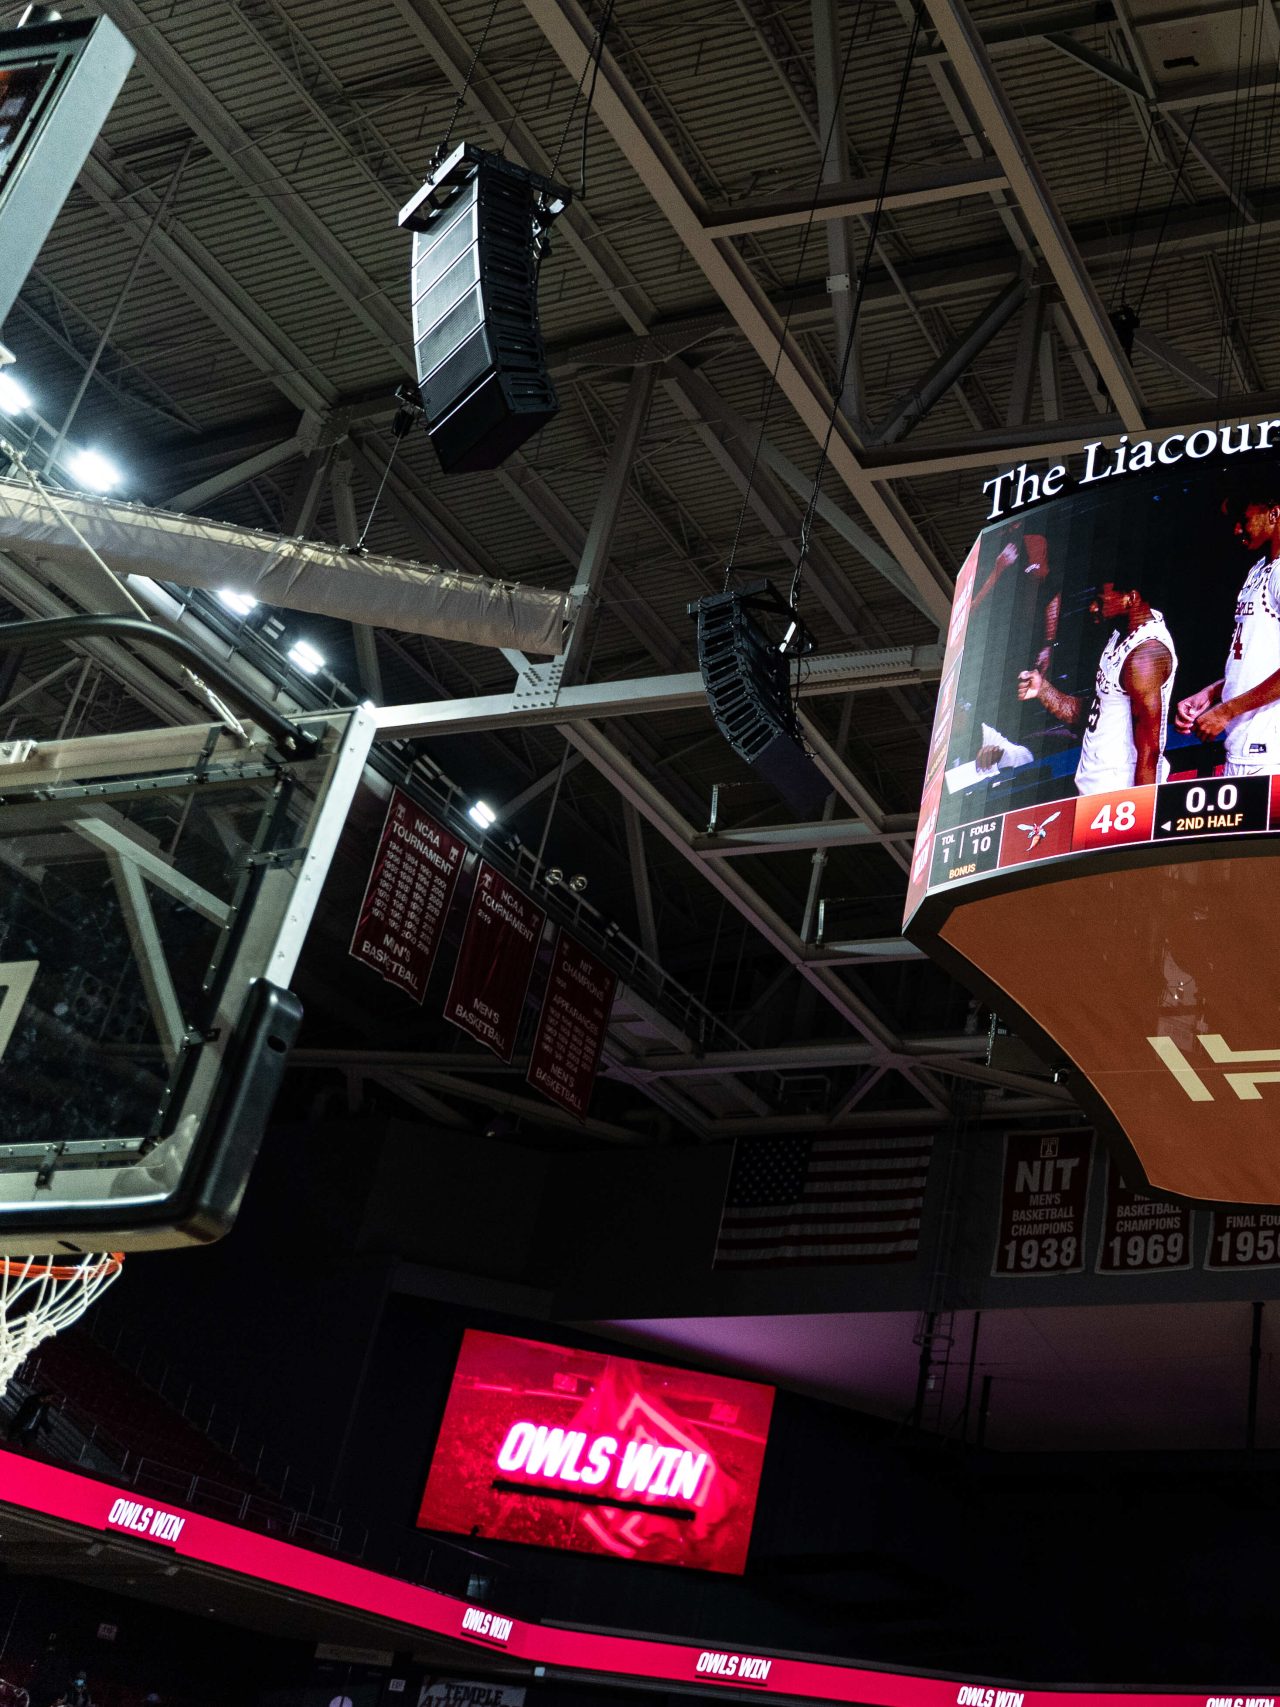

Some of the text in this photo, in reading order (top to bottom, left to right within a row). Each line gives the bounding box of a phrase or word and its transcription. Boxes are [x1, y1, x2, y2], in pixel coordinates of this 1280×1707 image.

[982, 464, 1066, 521] The
[1186, 784, 1238, 813] 0.0
[970, 822, 996, 837] FOULS
[1090, 801, 1136, 833] 48
[1176, 814, 1243, 831] 2ND HALF
[414, 819, 440, 848] NCAA
[941, 834, 955, 847] TOL
[971, 837, 991, 855] 10
[393, 820, 454, 876] TOURNAMENT
[942, 848, 950, 864] 1
[949, 863, 976, 879] BONUS
[481, 890, 534, 943] TOURNAMENT
[501, 890, 523, 917] NCAA
[383, 933, 411, 962] MN'S
[455, 1004, 505, 1051] BASKETBALL
[1015, 1157, 1080, 1192] NIT
[1029, 1193, 1061, 1207] MEN'S
[1116, 1203, 1182, 1218] BASKETBALL
[1012, 1206, 1075, 1222] BASKETBALL
[1116, 1217, 1181, 1233] CHAMPIONS
[1226, 1215, 1257, 1229] FINAL
[1011, 1221, 1074, 1237] CHAMPIONS
[1004, 1236, 1077, 1270] 1938
[1109, 1232, 1184, 1267] 1969
[497, 1422, 708, 1499] OWLS WIN
[108, 1498, 186, 1542] OWLS WIN
[462, 1607, 513, 1641] OWLS WIN
[696, 1652, 771, 1680] OWLS WIN
[447, 1683, 503, 1706] TEMPLE
[957, 1686, 1024, 1707] OWLS WIN
